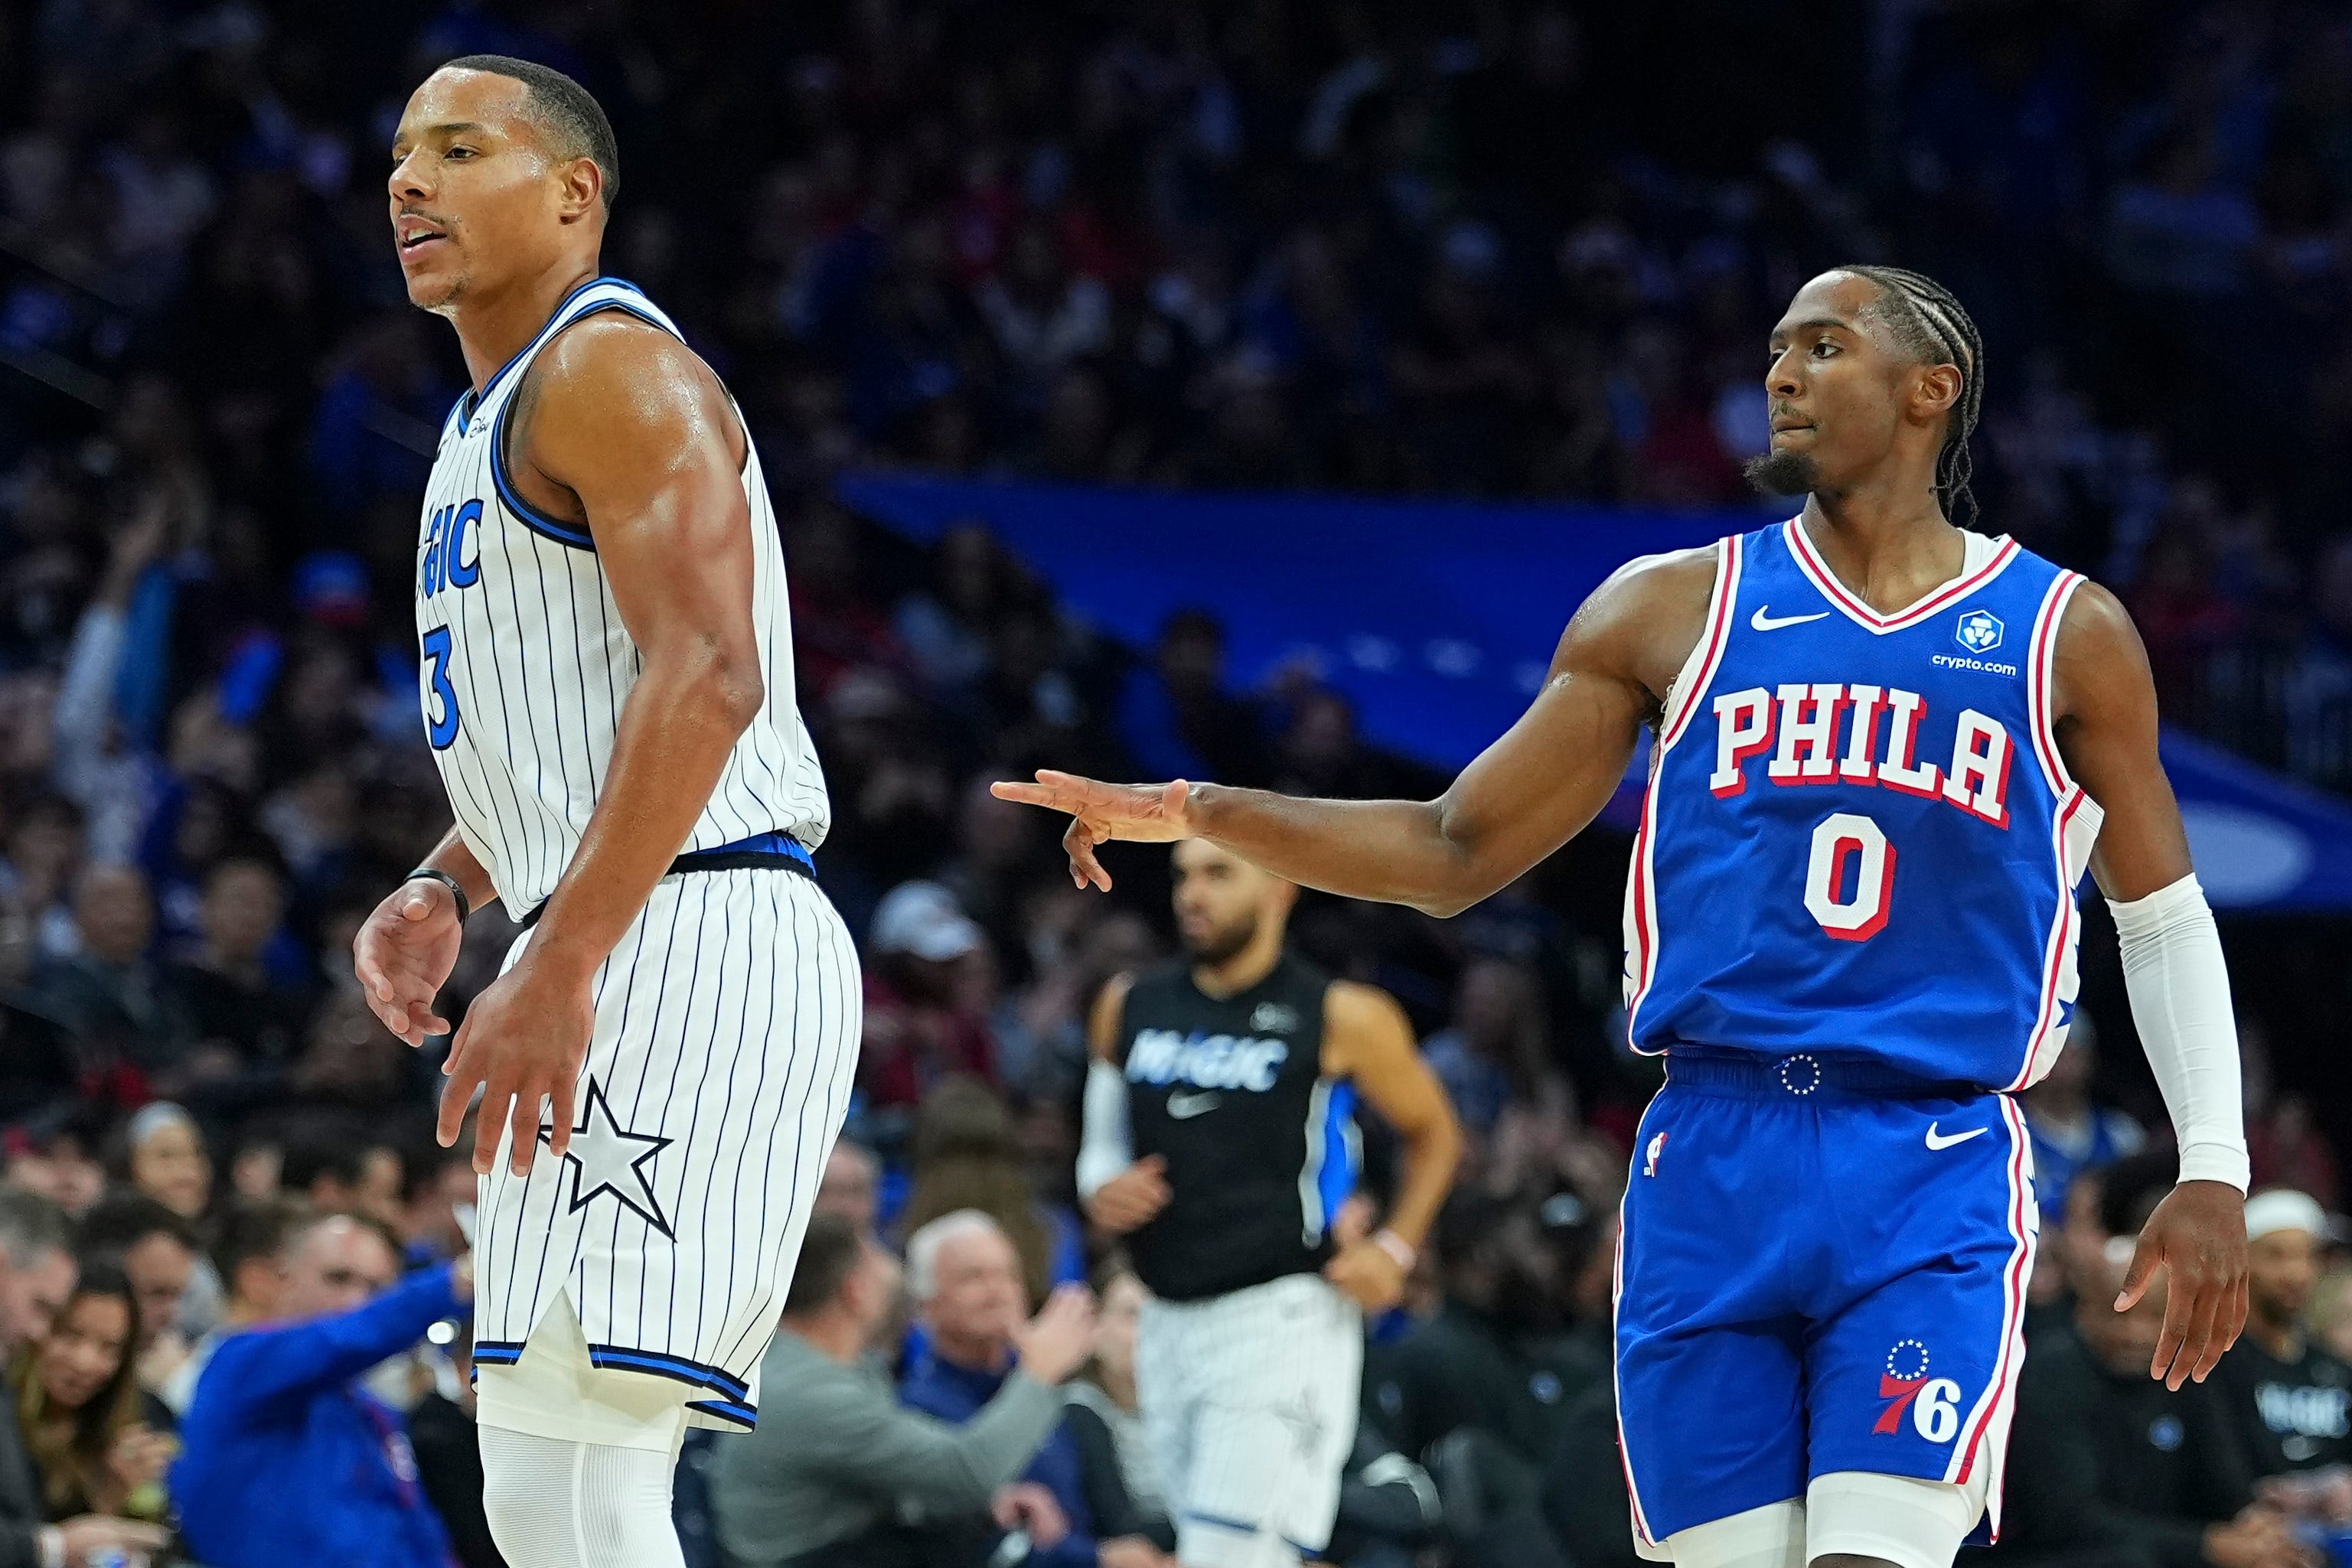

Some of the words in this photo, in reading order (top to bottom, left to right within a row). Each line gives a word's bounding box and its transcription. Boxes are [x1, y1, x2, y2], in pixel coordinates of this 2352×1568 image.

[418, 498, 484, 600] GIC
[1932, 655, 2017, 676] crypto.com
[1710, 683, 2014, 830] PHILA
[1803, 813, 1897, 942] 0
[1872, 1373, 1961, 1443] 76
